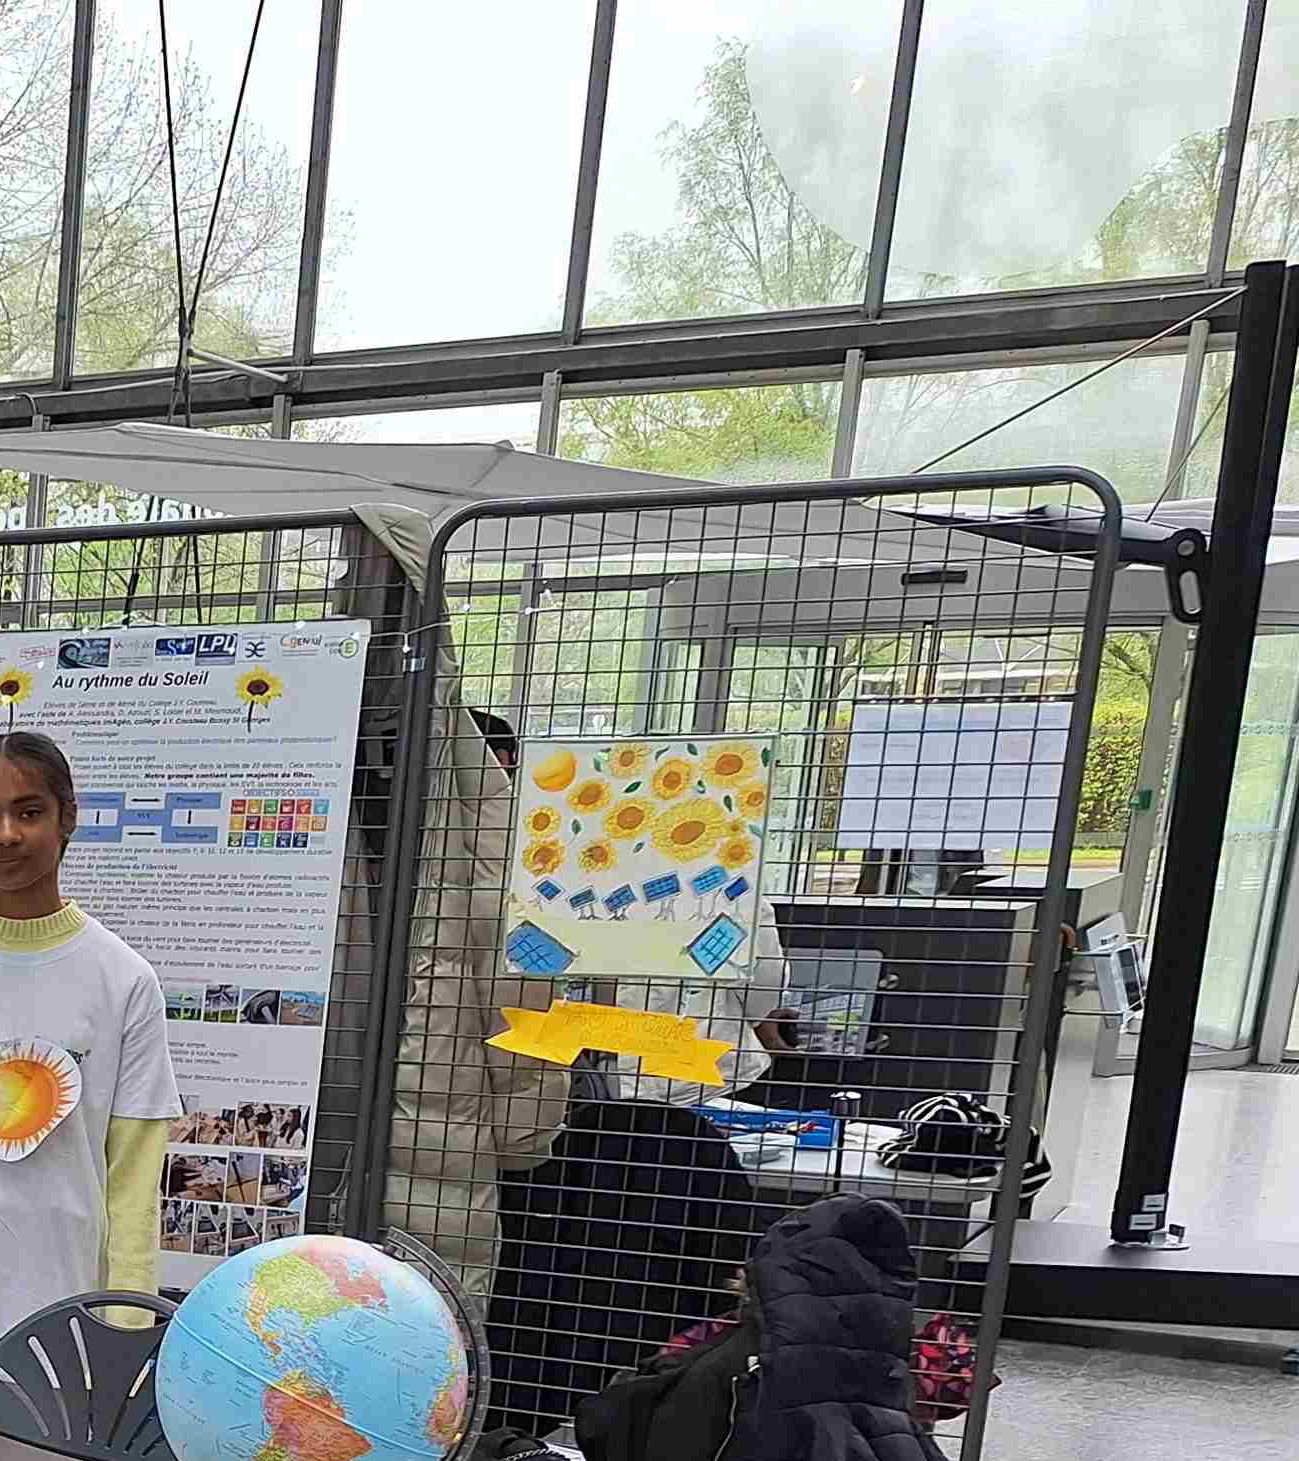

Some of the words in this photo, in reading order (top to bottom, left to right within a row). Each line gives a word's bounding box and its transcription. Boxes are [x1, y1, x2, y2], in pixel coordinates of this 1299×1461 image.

[53, 675, 73, 688] Au
[77, 674, 133, 692] rythme
[138, 672, 160, 686] du
[162, 671, 210, 686] Soleil
